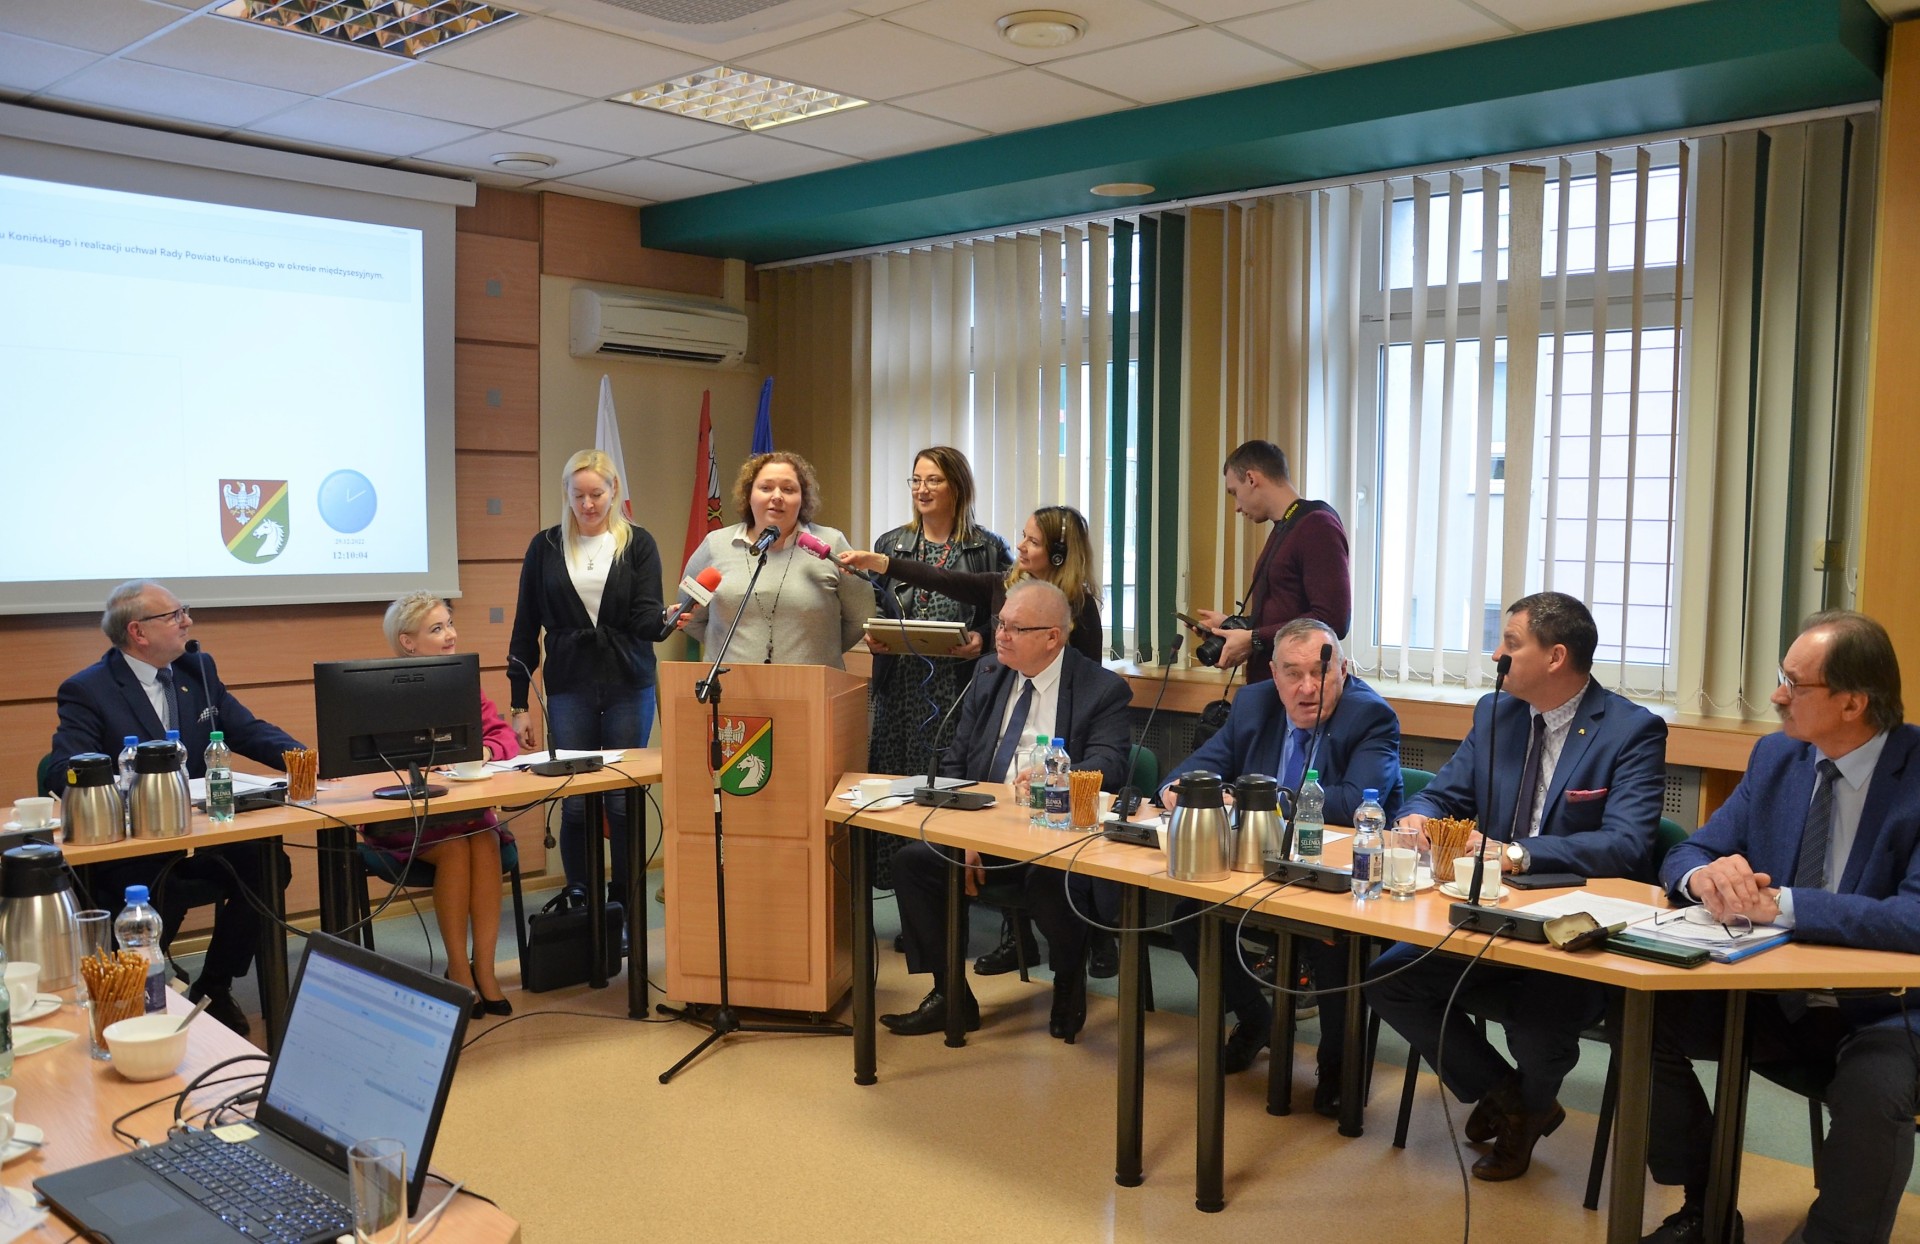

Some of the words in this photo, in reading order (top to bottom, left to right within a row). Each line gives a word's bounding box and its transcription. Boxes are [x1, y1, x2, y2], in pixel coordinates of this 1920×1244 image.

[8, 231, 72, 248] Konińskiego
[74, 238, 78, 247] i
[80, 240, 122, 253] realizacji
[125, 245, 157, 255] uchwał
[160, 248, 183, 260] Rady
[185, 251, 221, 262] Powiatu
[223, 255, 275, 269] Konińskiego
[287, 262, 316, 272] okresie
[1284, 503, 1299, 520] Nikon
[391, 674, 425, 684] ASUS
